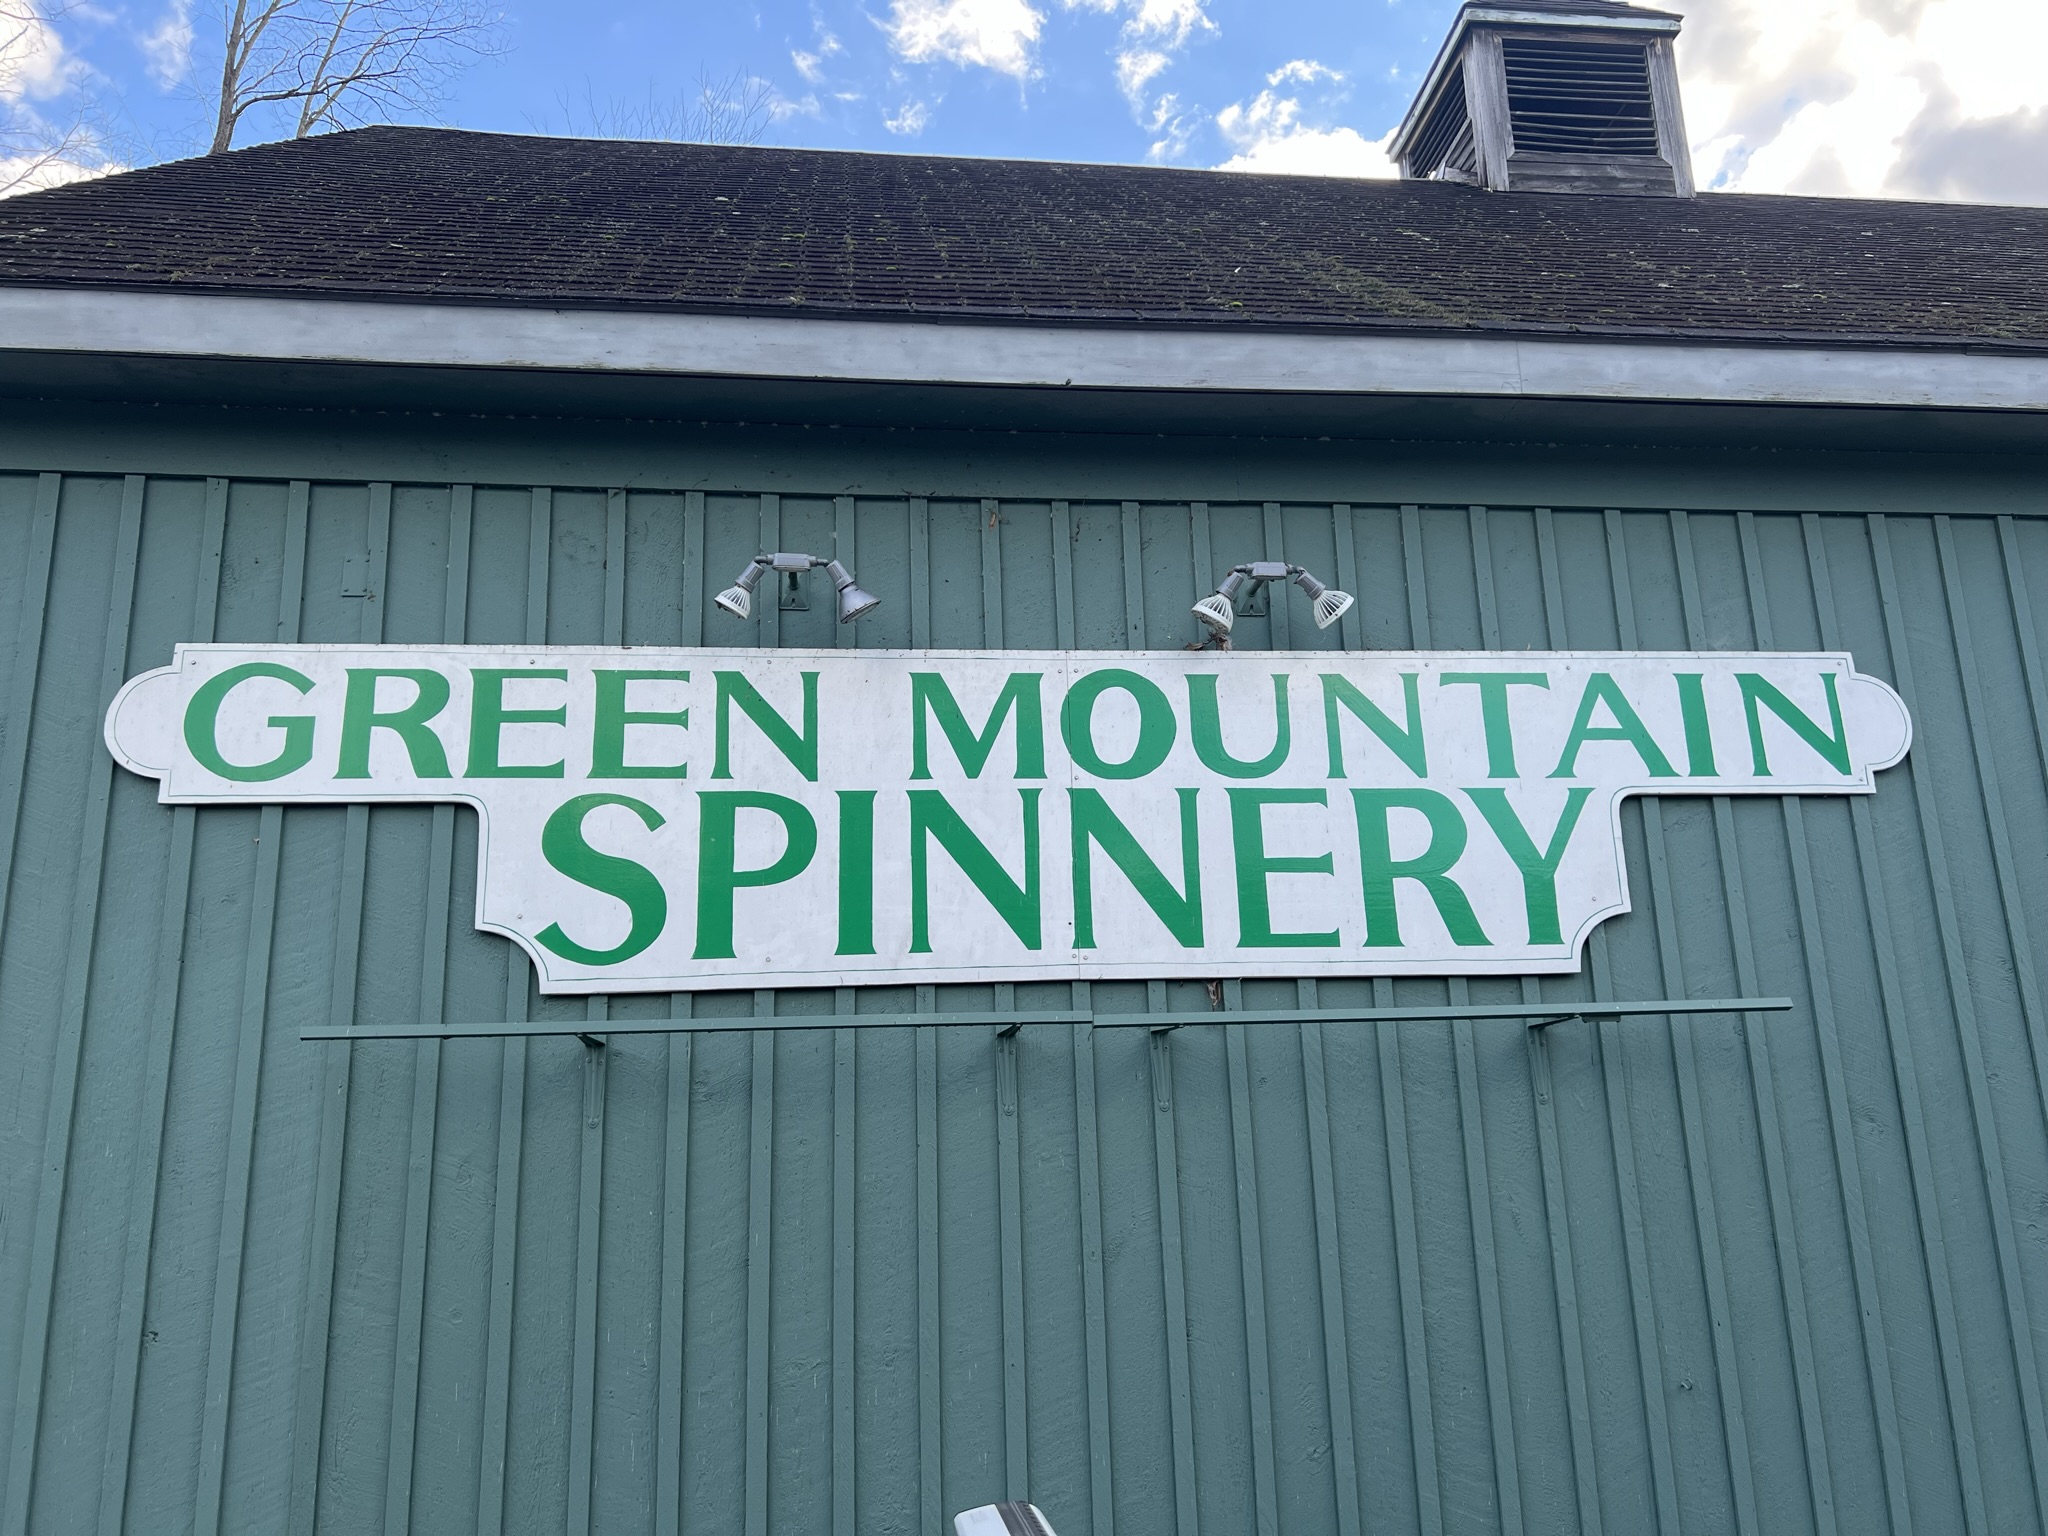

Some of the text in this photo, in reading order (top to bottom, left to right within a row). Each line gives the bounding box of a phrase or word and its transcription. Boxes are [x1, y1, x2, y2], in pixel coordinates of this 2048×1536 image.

[184, 662, 1852, 782] GREEN MOUNTAIN
[535, 788, 1594, 966] SPINNERY
